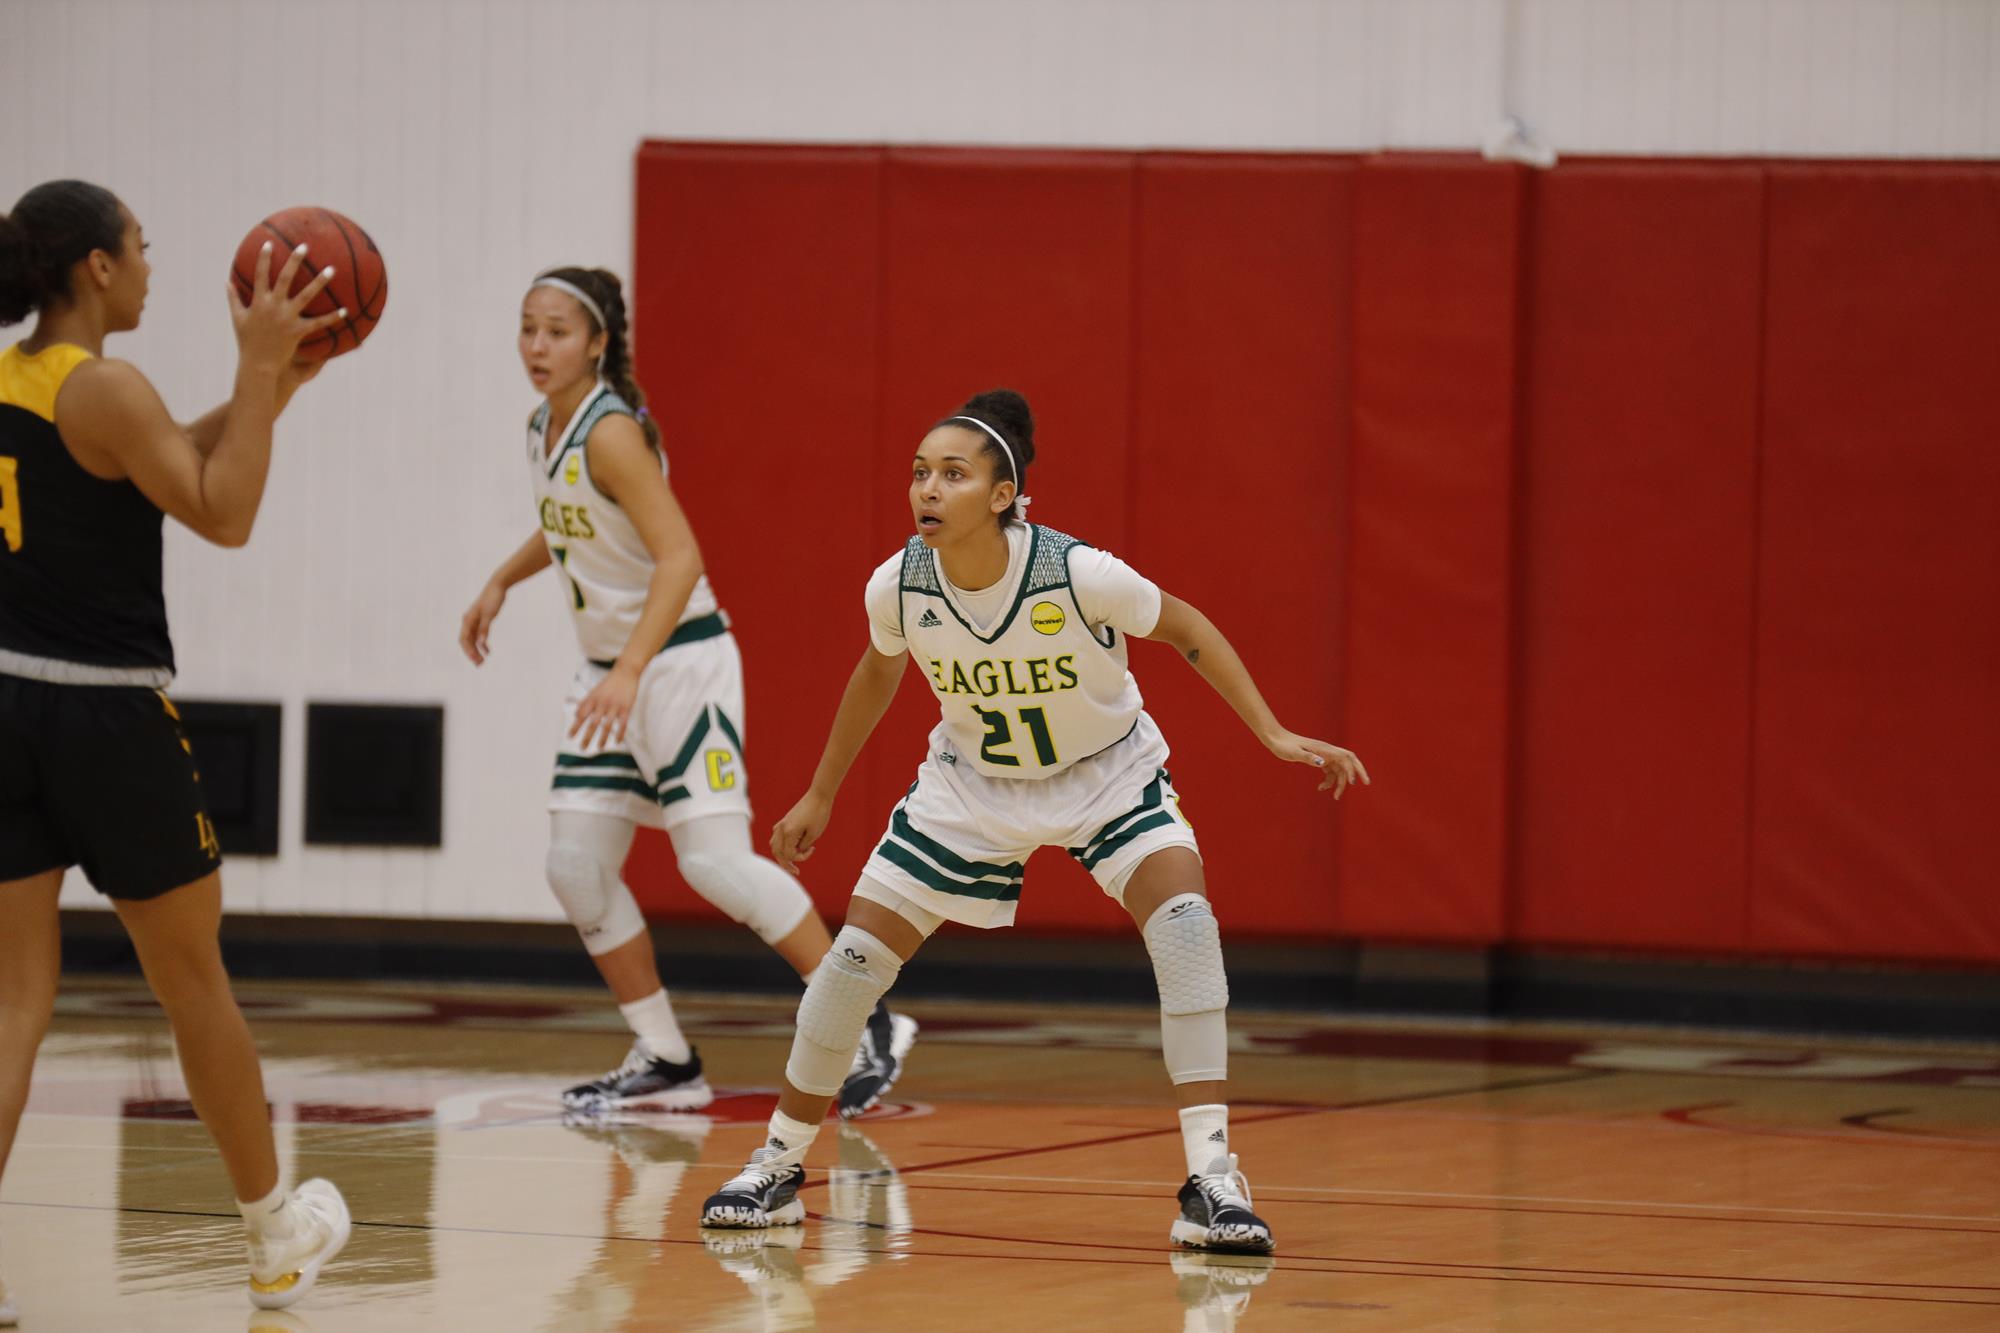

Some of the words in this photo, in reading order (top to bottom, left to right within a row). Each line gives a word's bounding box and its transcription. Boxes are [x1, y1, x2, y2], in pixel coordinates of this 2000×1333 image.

[929, 654, 1079, 697] EAGLES
[970, 703, 1058, 767] 21
[705, 749, 736, 792] C
